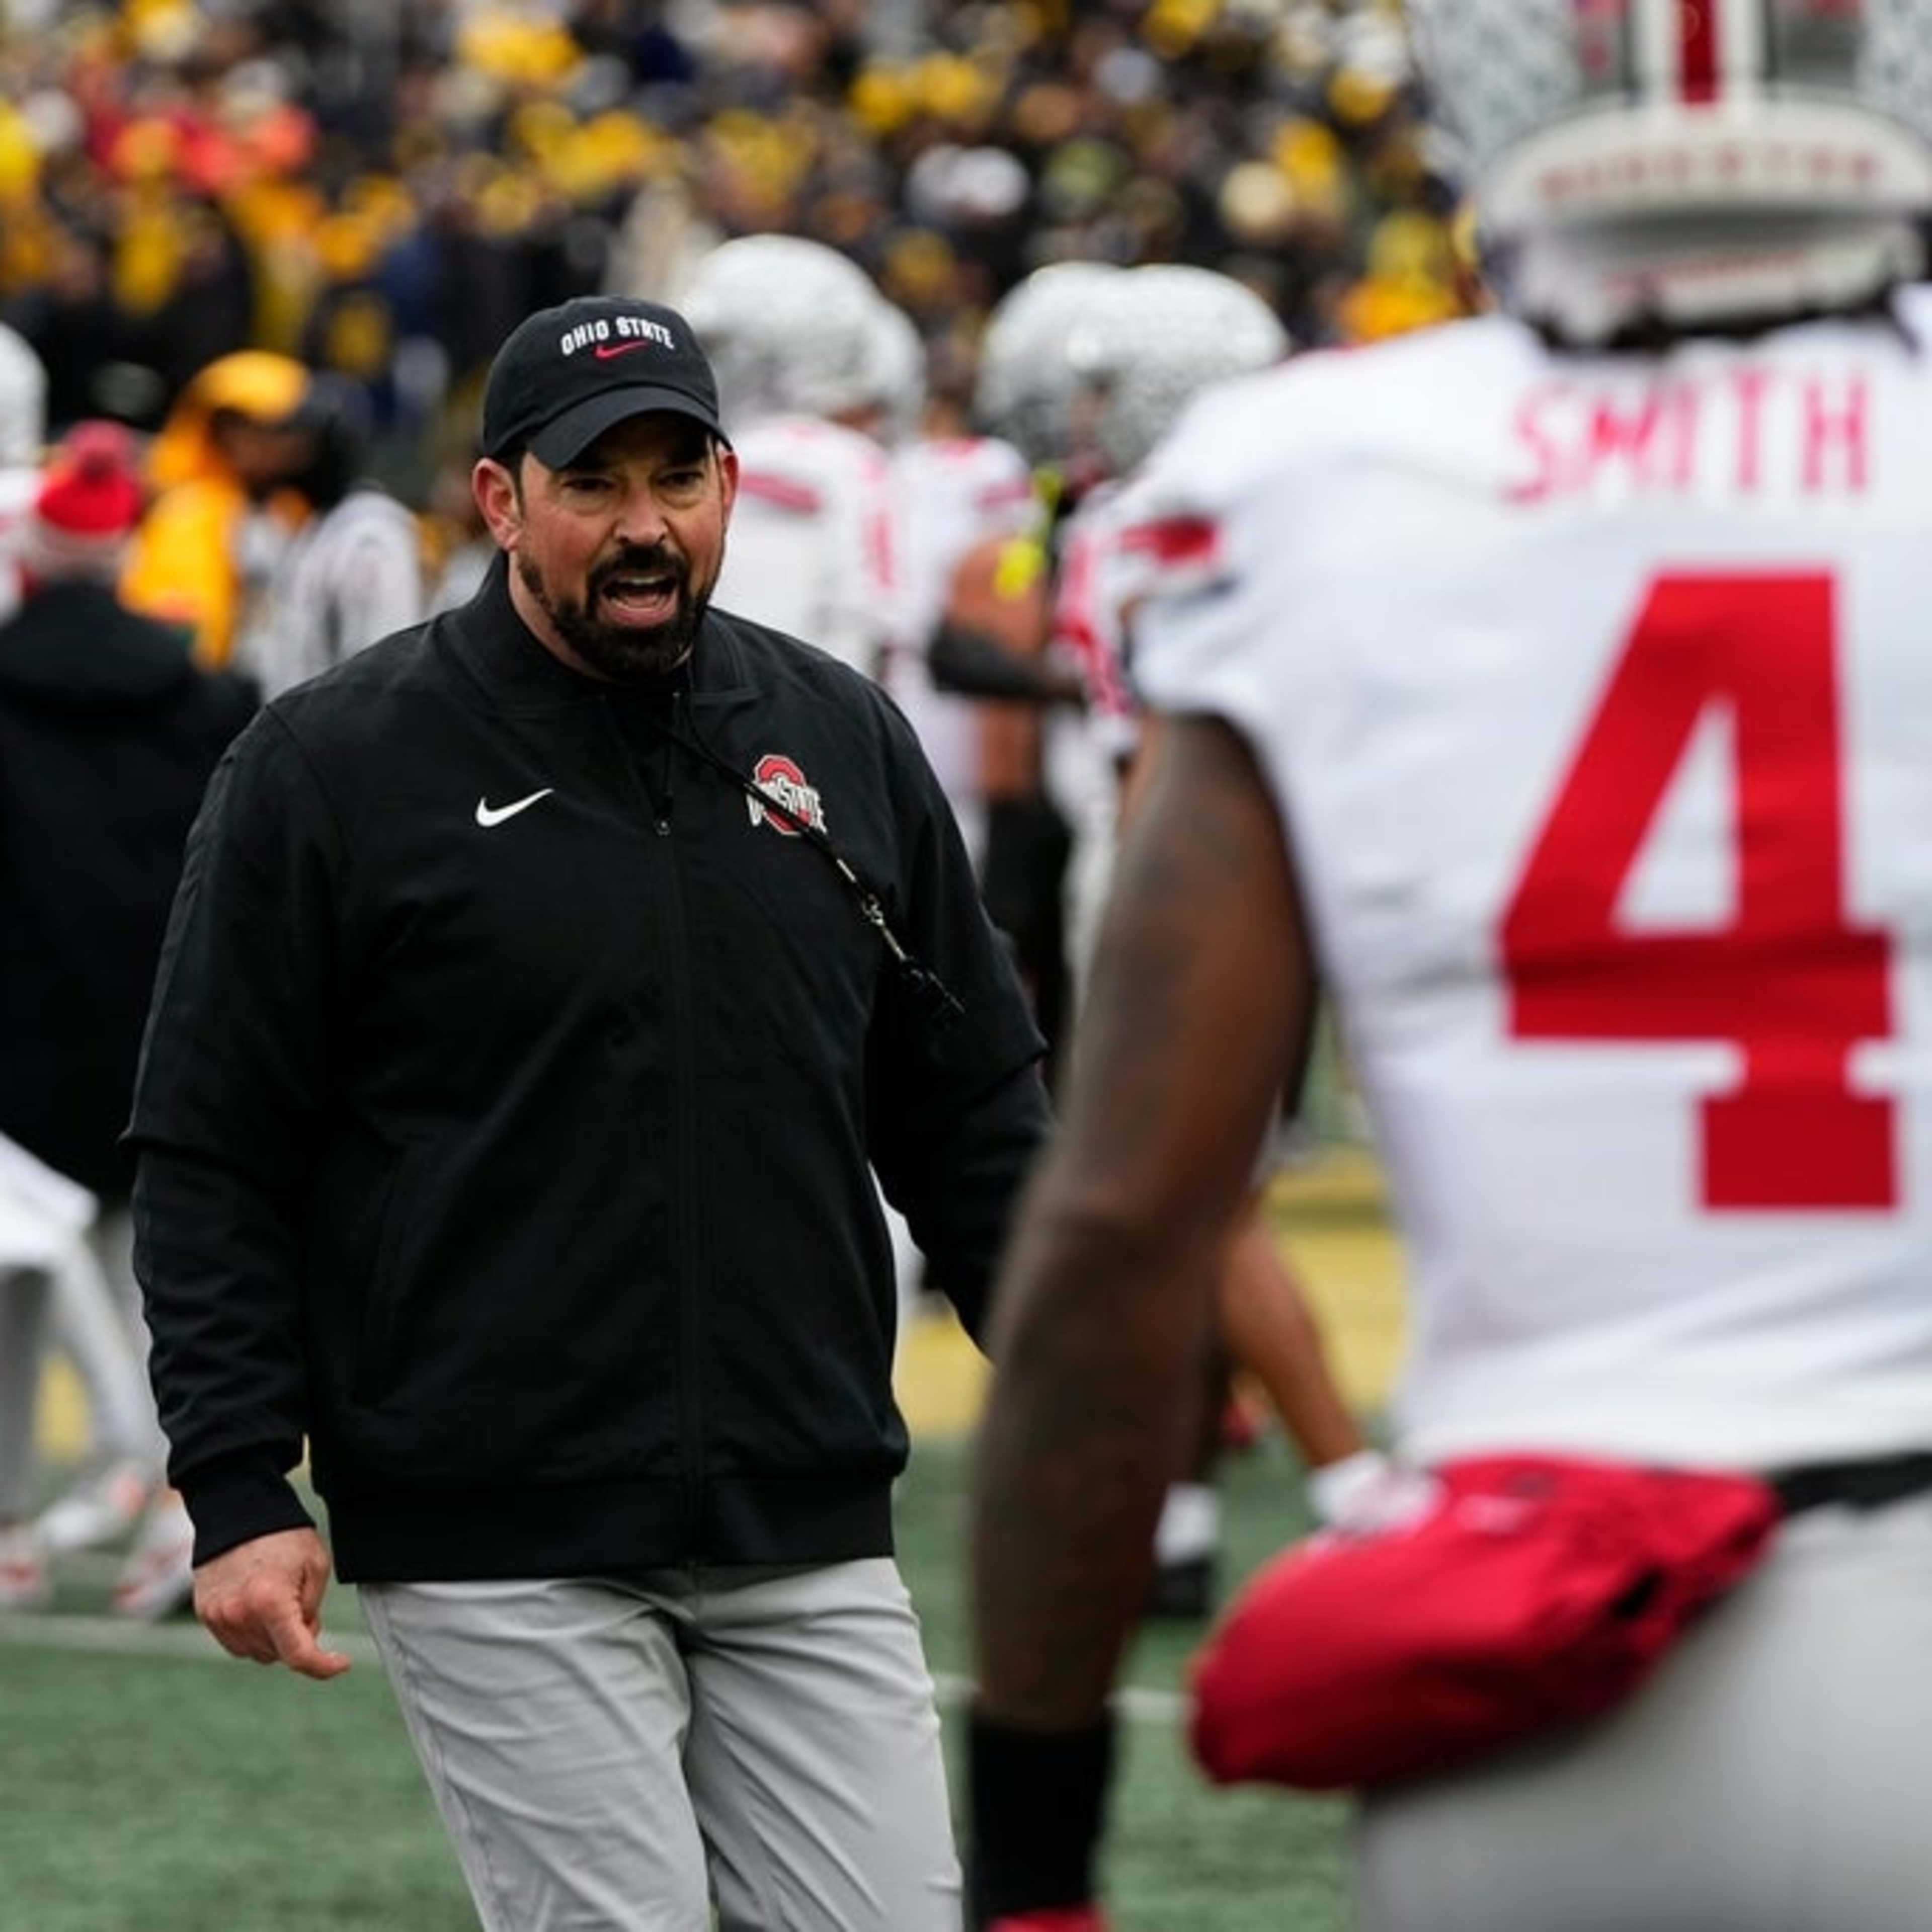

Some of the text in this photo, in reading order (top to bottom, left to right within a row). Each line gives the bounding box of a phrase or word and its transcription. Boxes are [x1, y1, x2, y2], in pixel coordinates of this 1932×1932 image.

[560, 315, 675, 356] OHIO STATE
[1504, 370, 1869, 504] SMITH
[1496, 571, 1898, 1212] 4
